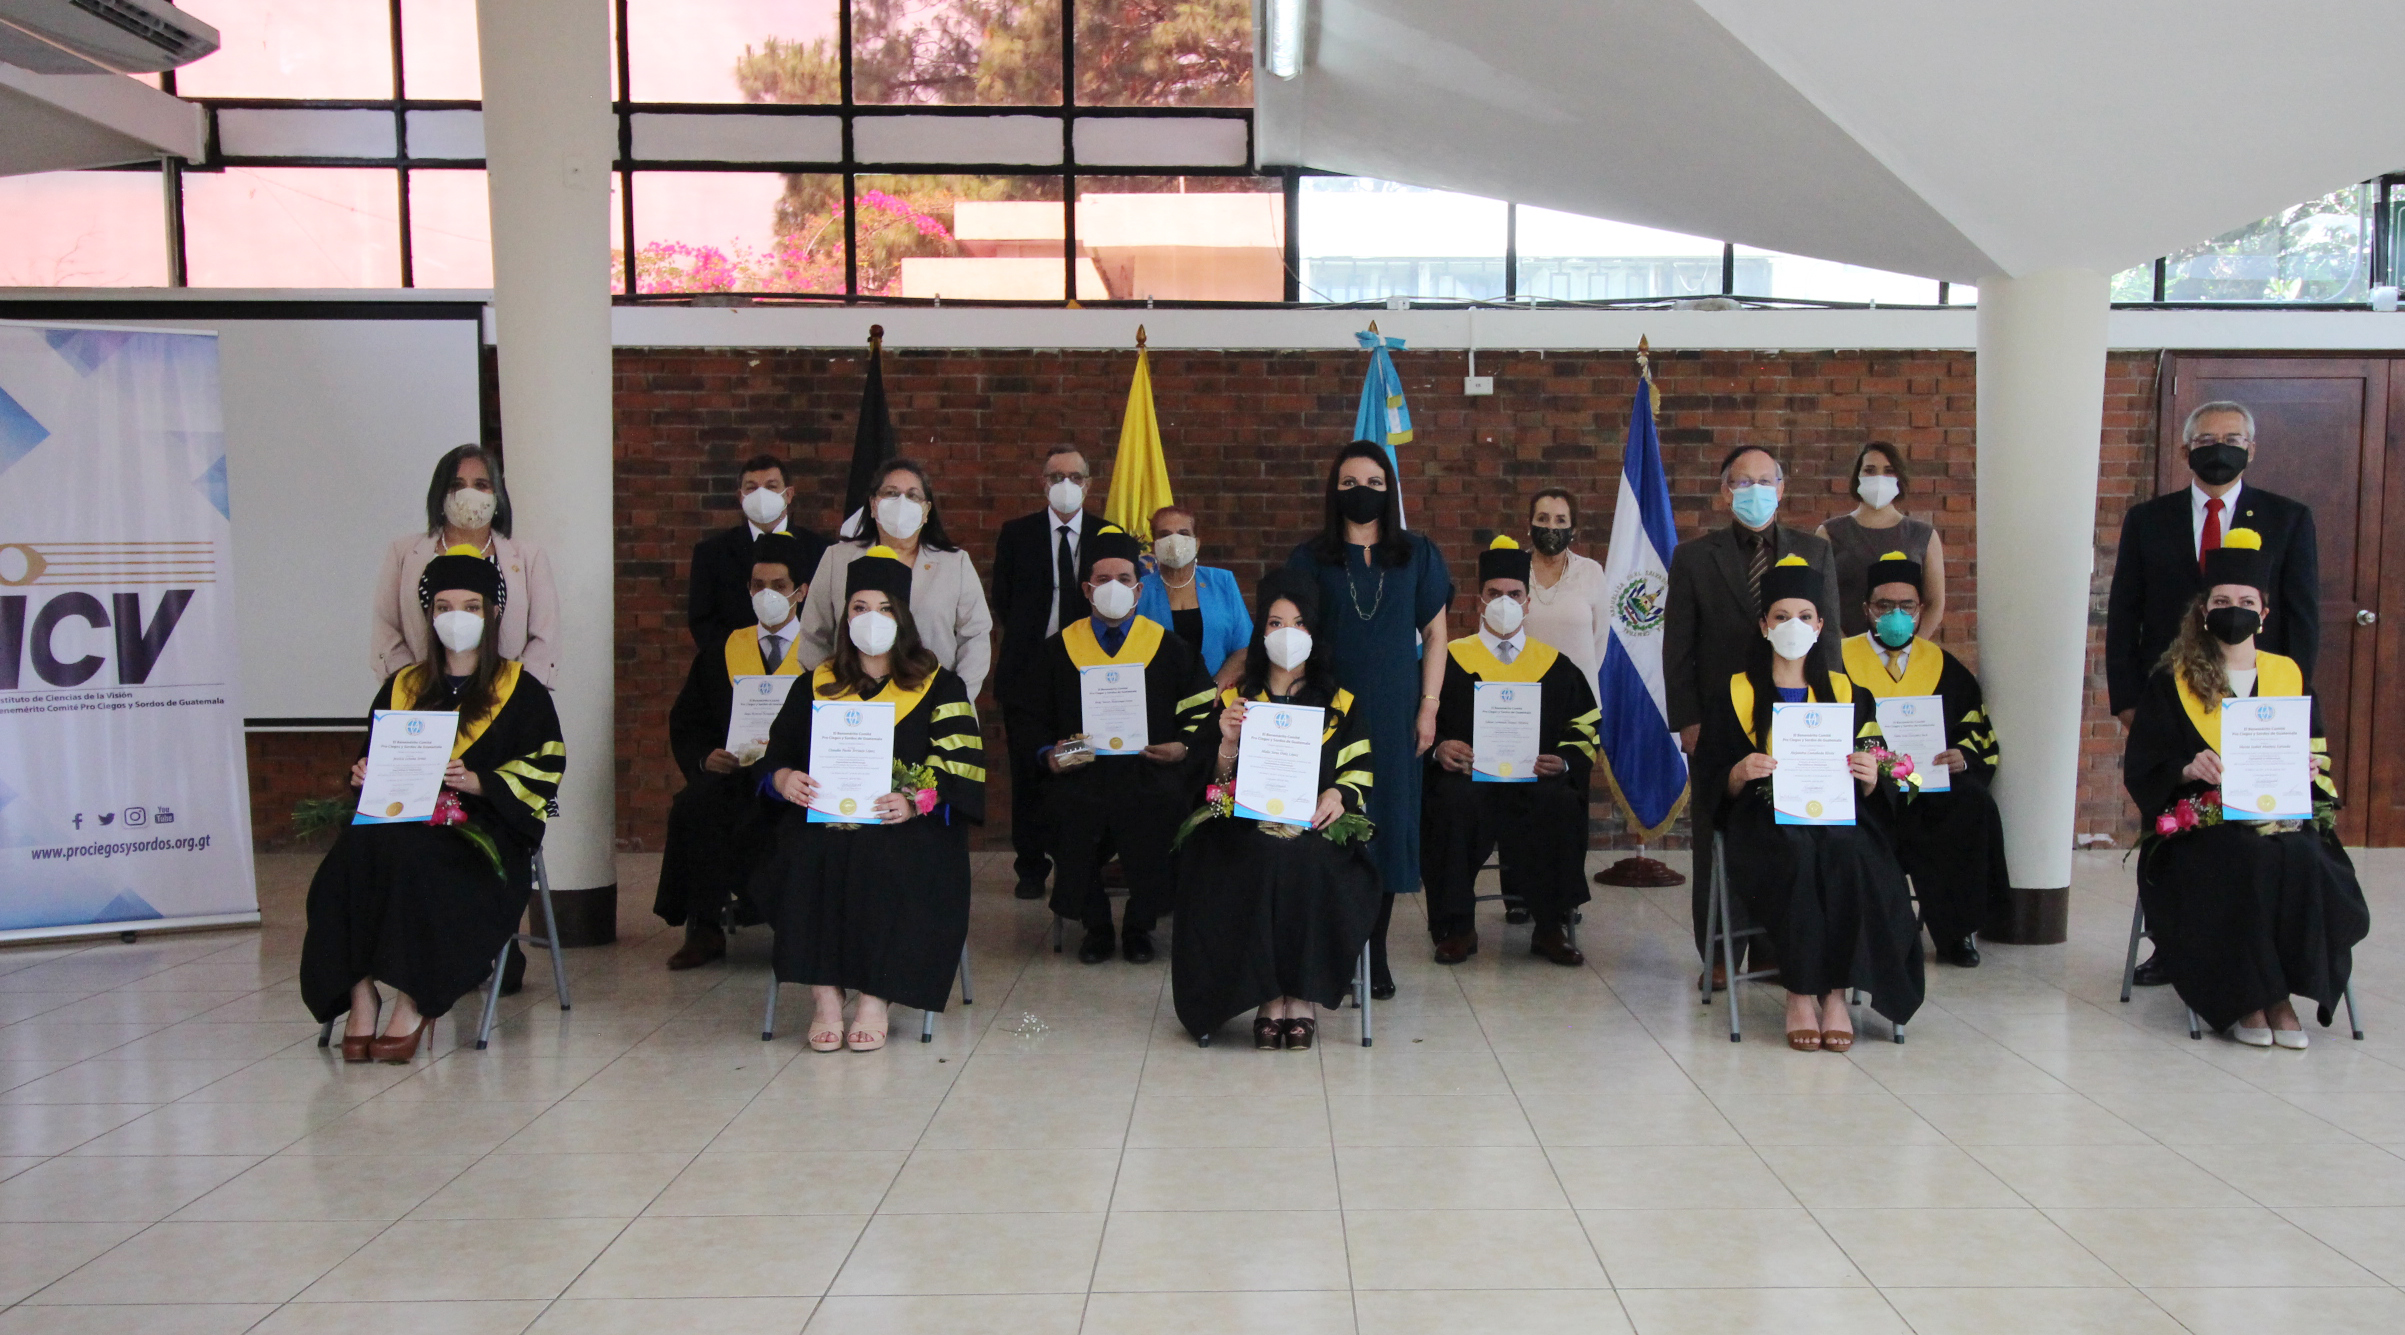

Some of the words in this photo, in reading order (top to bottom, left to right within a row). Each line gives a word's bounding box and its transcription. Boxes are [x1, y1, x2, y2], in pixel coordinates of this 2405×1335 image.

[46, 704, 78, 712] Comité
[97, 702, 126, 710] Ciegos
[178, 698, 224, 706] Guatemala
[32, 834, 211, 862] www.prociegosysordos.org.gt
